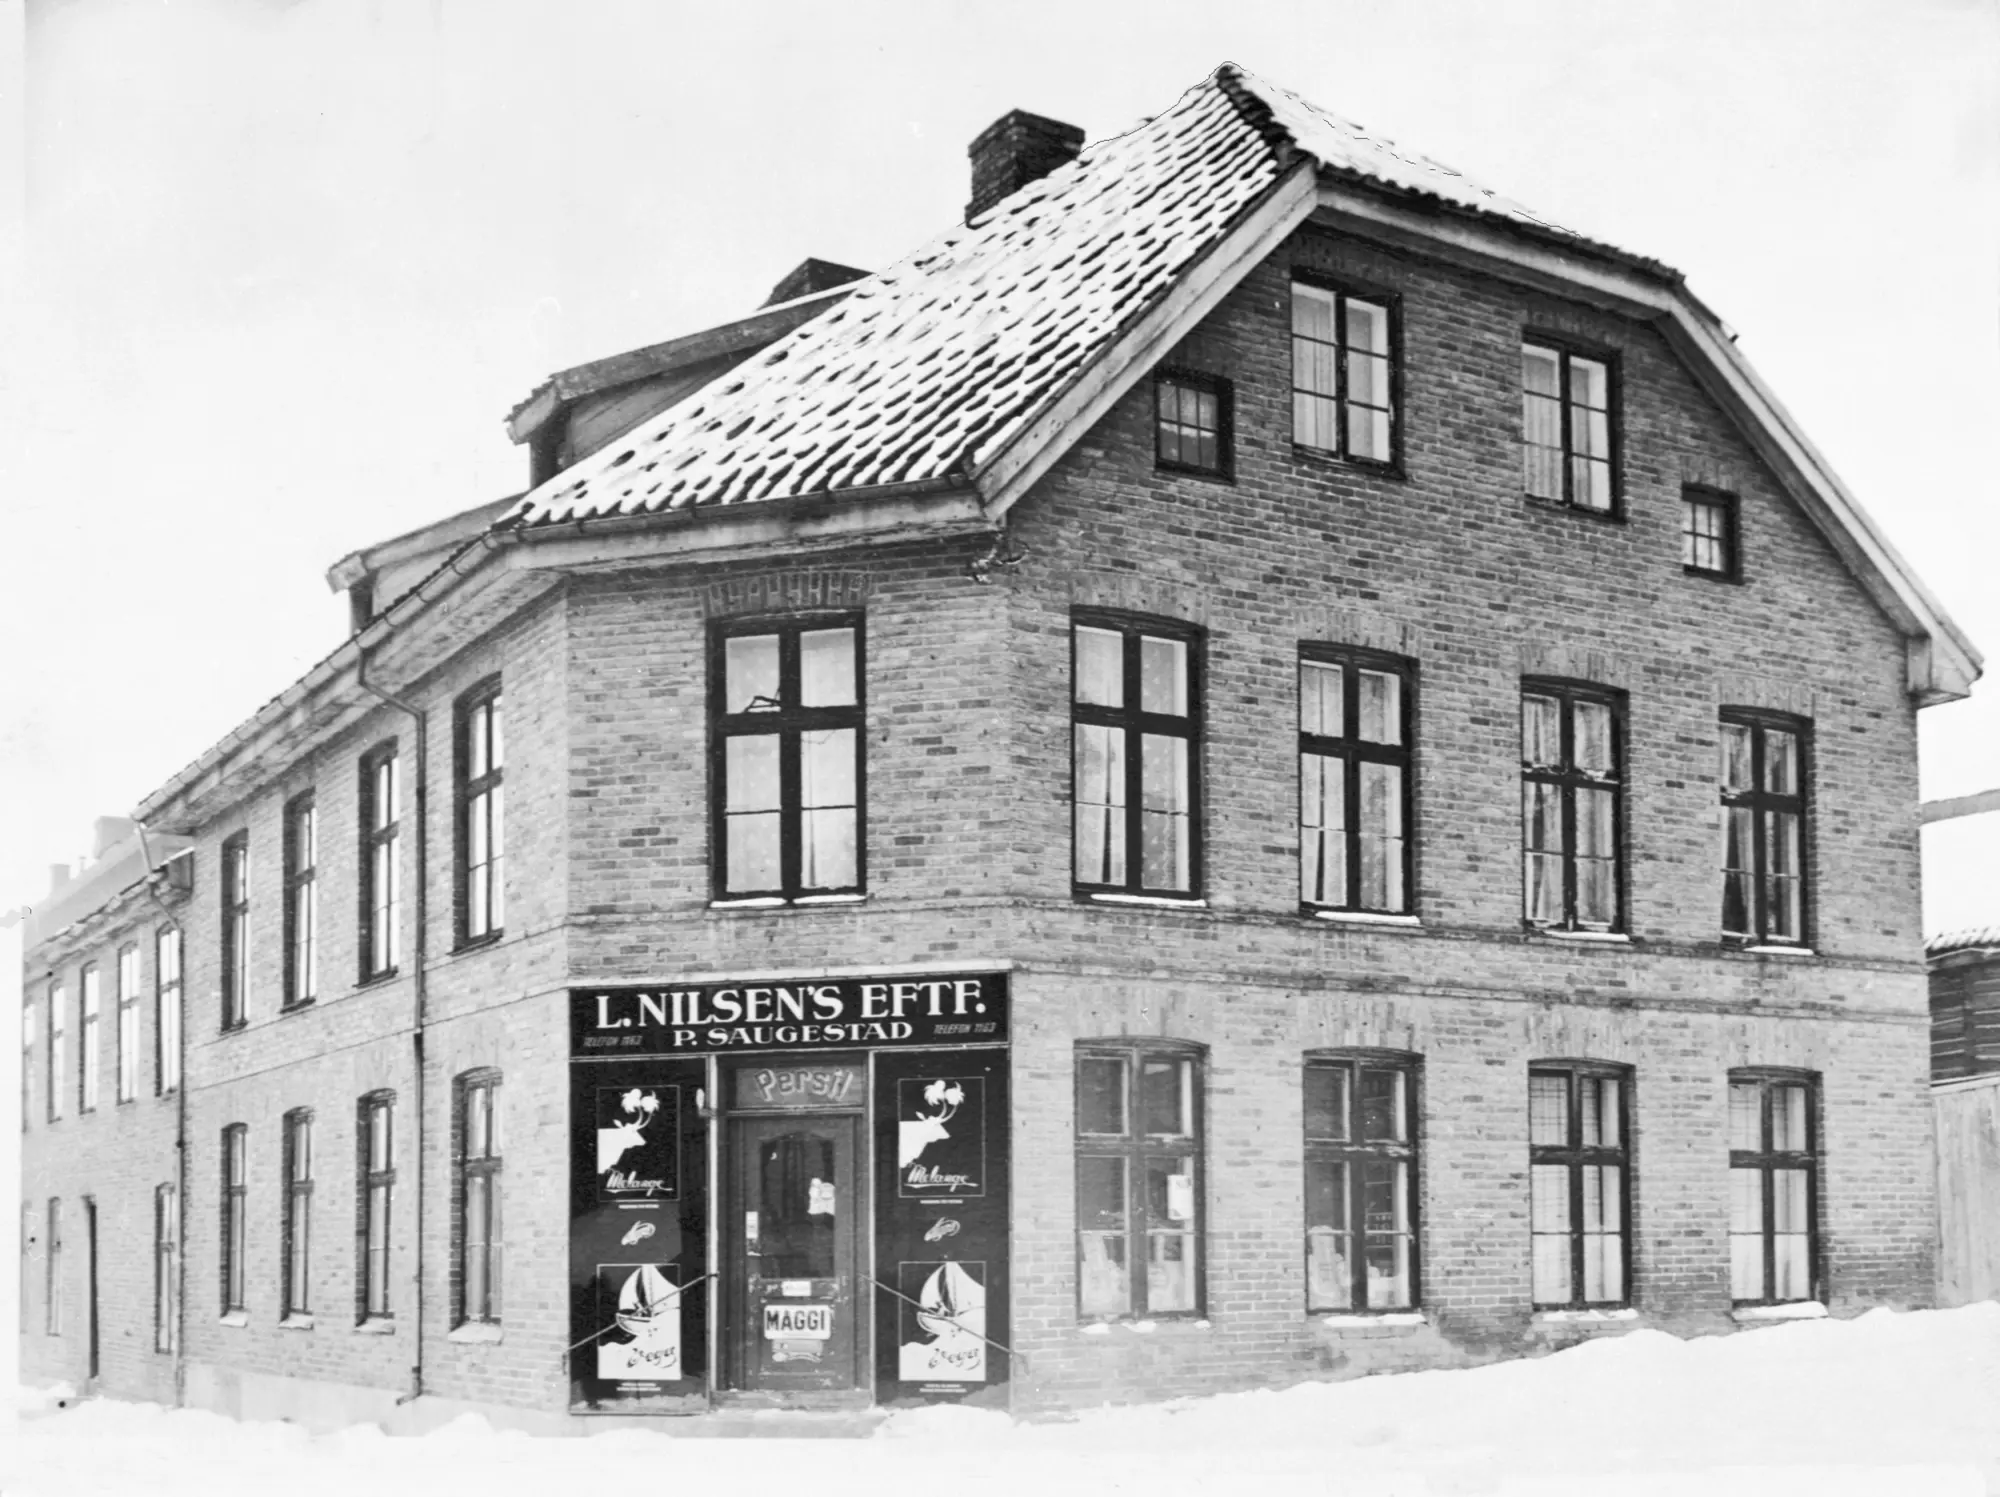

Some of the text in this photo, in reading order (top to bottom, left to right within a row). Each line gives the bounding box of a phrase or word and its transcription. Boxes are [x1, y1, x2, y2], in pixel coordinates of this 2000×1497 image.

[596, 979, 987, 1029] L. NILSEN'S EFTF.
[673, 1022, 913, 1047] P. SAUGESTAD
[754, 1067, 854, 1102] Persil
[766, 1310, 825, 1331] MAGGI
